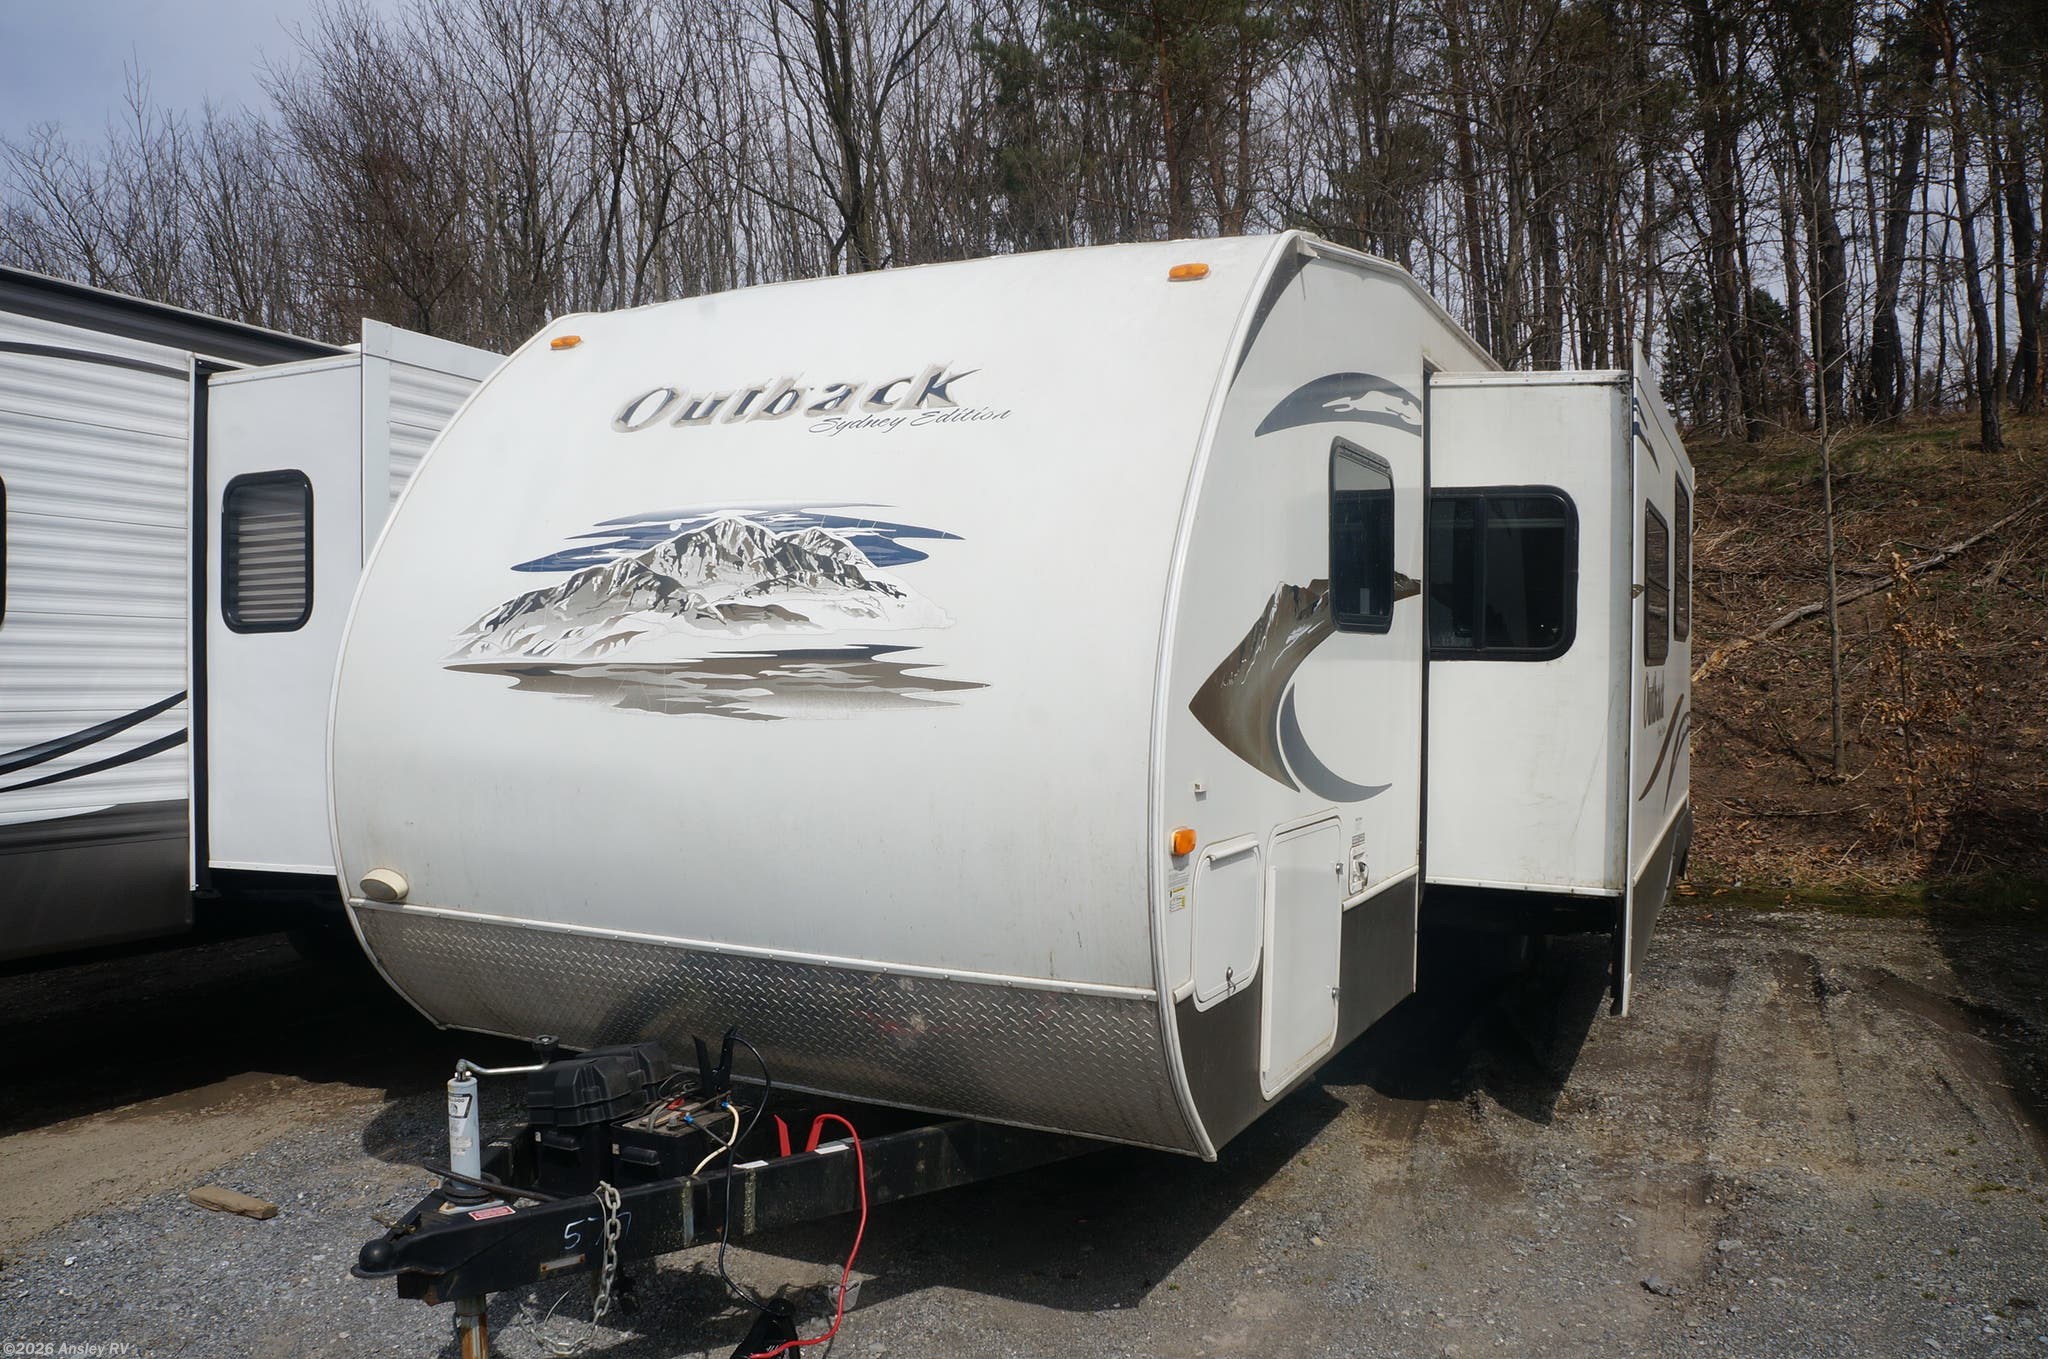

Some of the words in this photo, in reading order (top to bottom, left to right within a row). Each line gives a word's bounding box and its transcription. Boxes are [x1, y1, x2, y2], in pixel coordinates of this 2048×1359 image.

[611, 360, 982, 433] Outback
[808, 414, 908, 438] Sydney
[910, 407, 1012, 427] Edition
